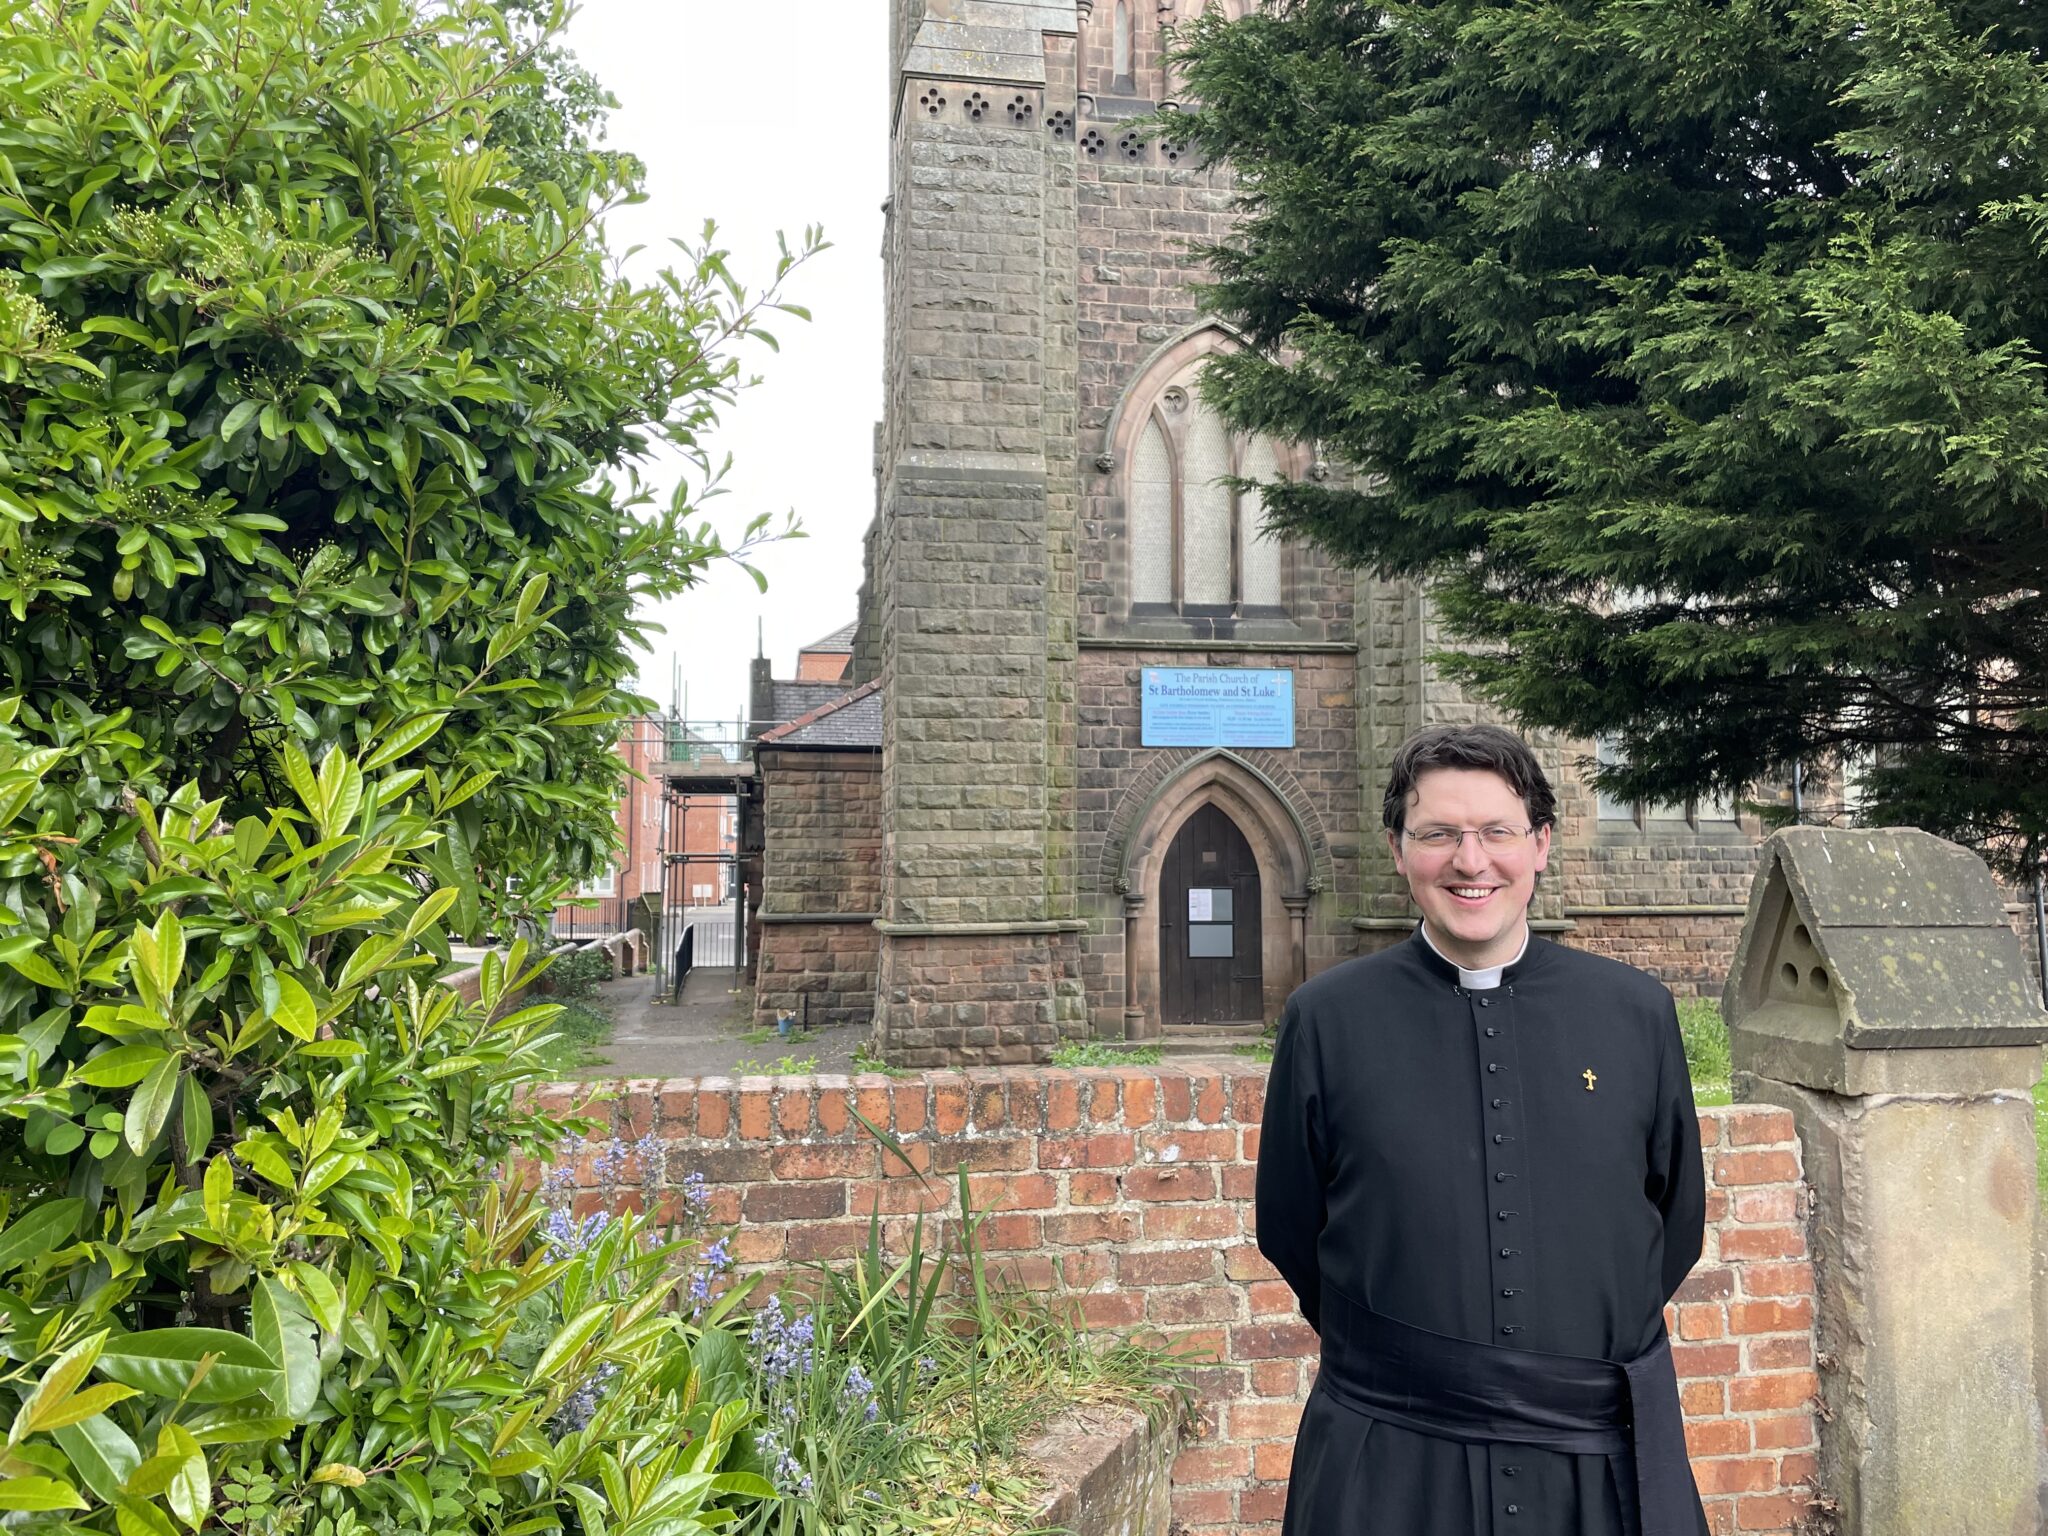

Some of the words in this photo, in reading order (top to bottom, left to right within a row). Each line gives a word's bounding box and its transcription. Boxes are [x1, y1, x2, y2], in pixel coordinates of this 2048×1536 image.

[1175, 673, 1192, 683] The
[1193, 673, 1218, 683] Parish
[1219, 673, 1249, 684] Church
[1250, 673, 1260, 684] of
[1148, 685, 1159, 696] St
[1161, 685, 1220, 697] Bartholomew
[1223, 686, 1239, 697] and
[1241, 686, 1251, 697] St
[1252, 686, 1276, 697] Luke
